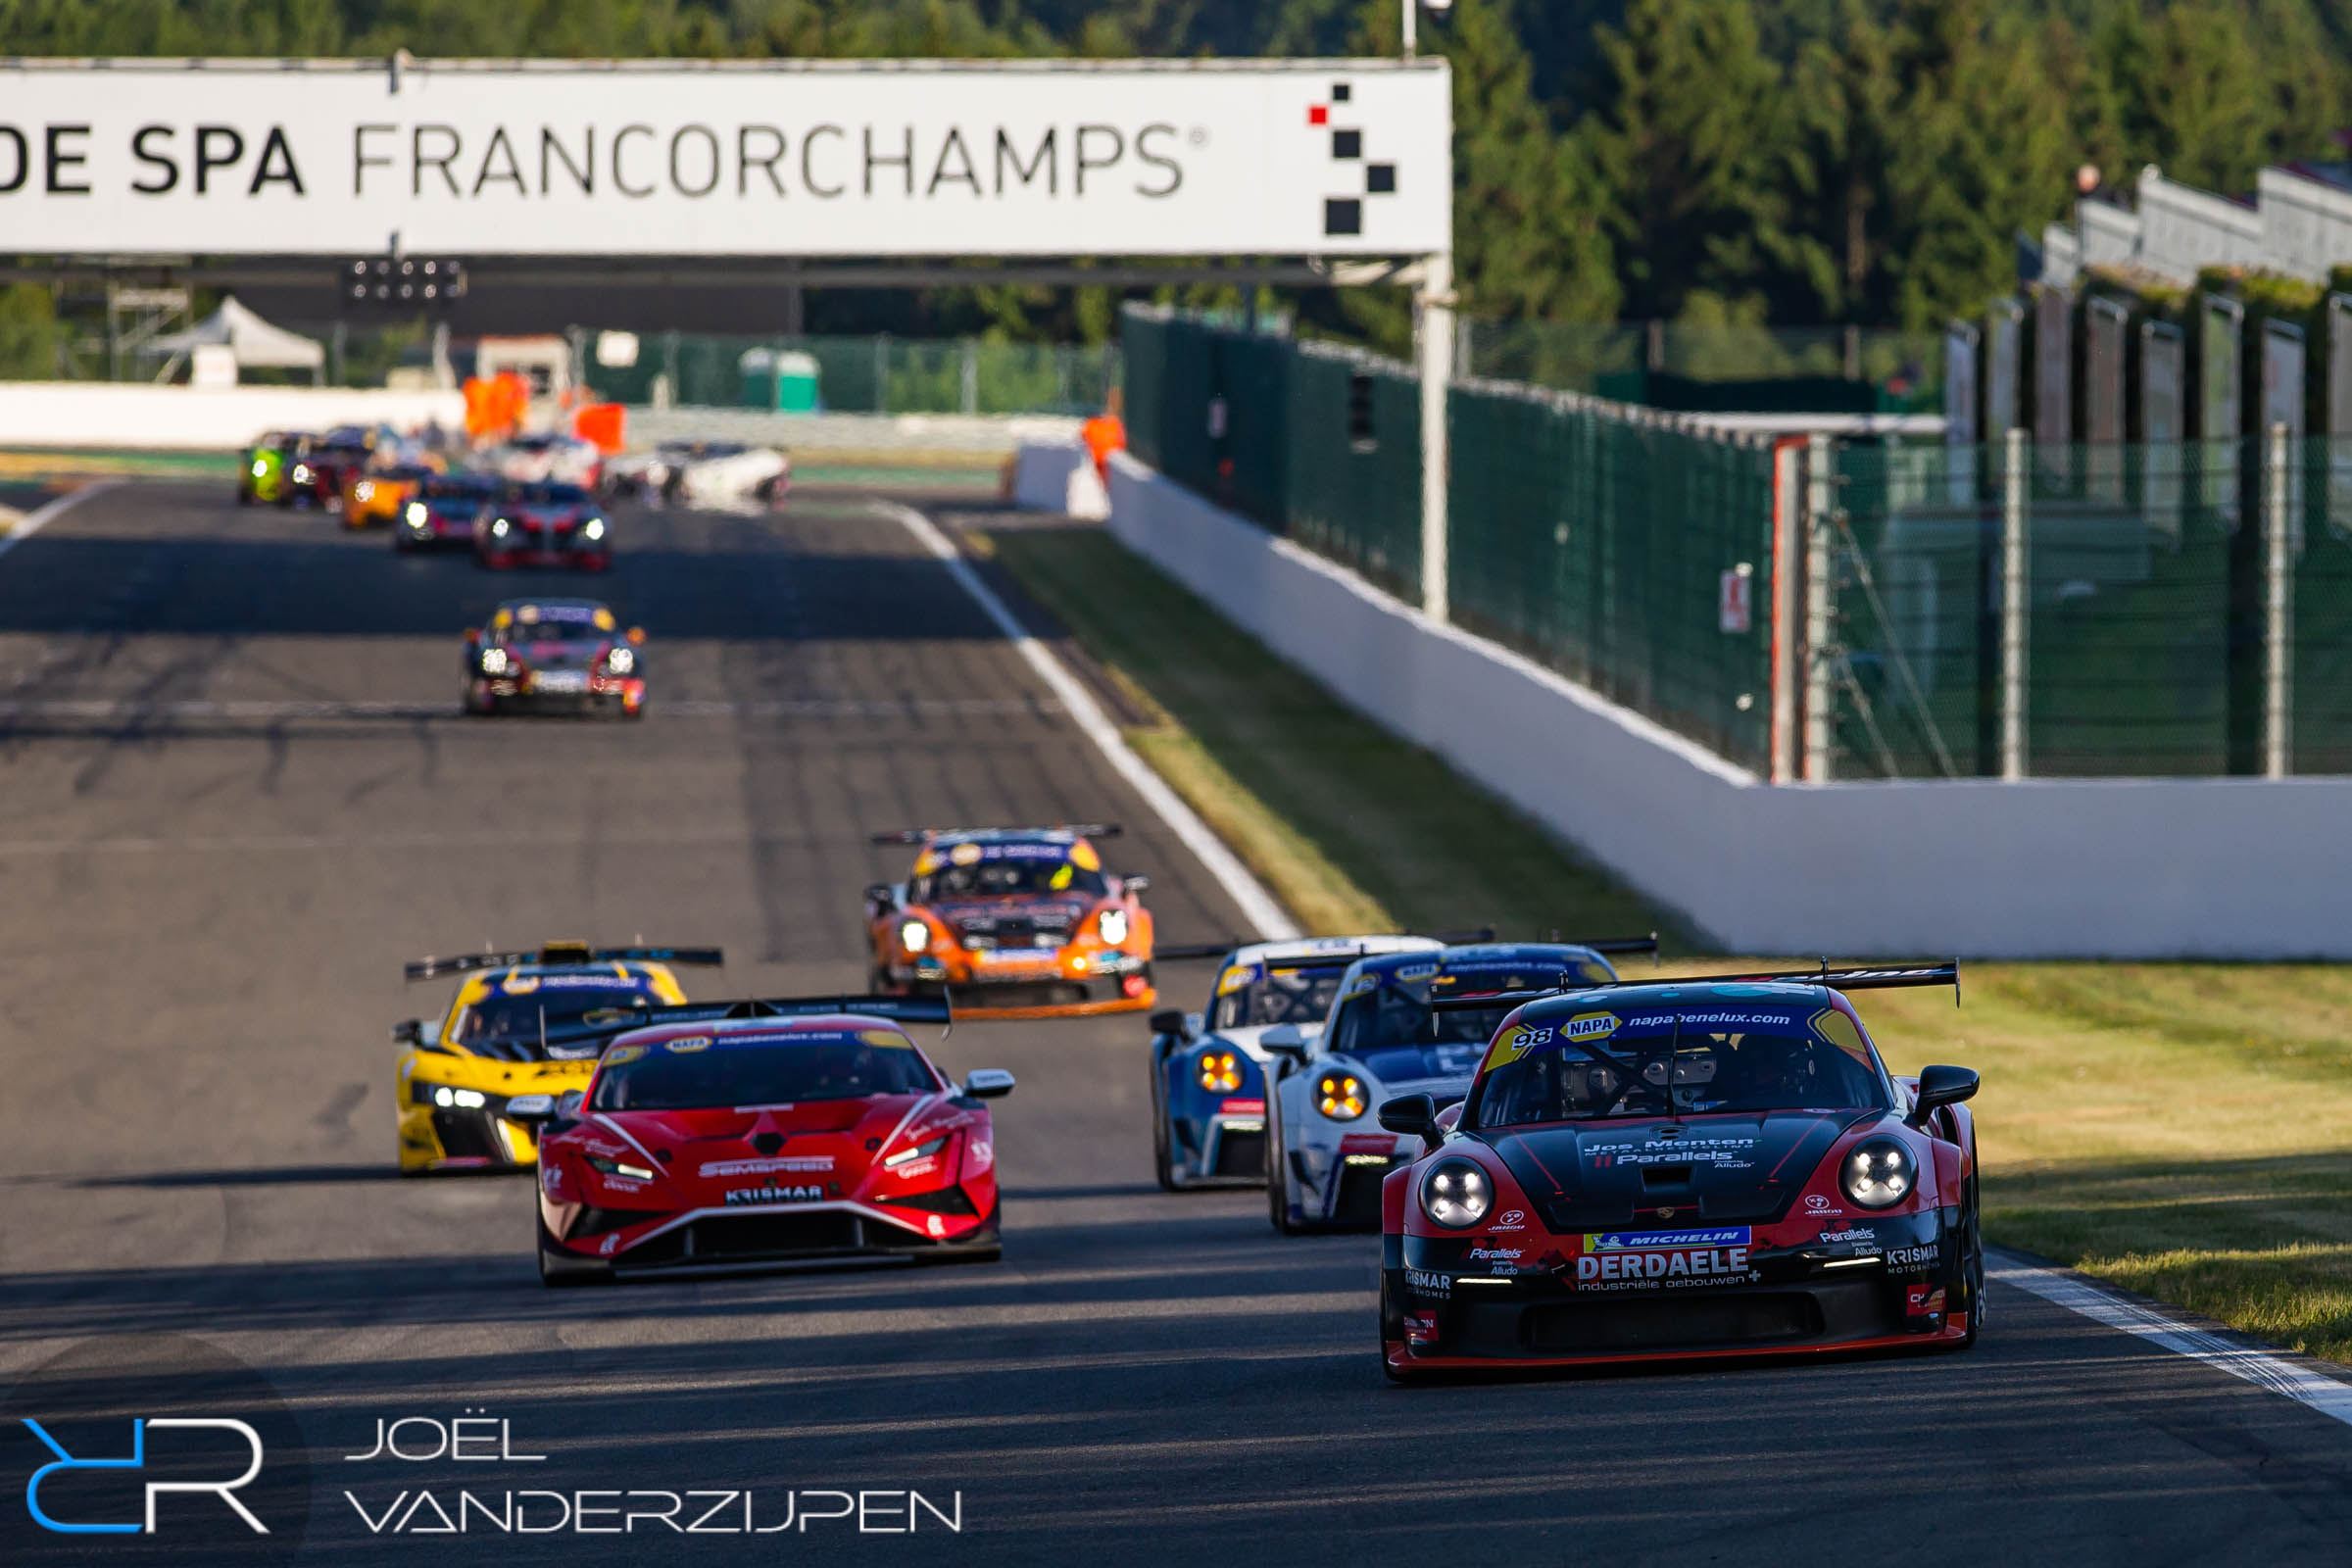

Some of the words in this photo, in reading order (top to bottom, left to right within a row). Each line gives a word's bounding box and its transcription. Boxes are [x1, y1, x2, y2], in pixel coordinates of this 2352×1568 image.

[130, 124, 306, 196] SPA
[353, 123, 1185, 198] FRANCORCHAMPS
[1569, 1018, 1615, 1036] NAPA
[1512, 1027, 1552, 1050] 98
[1584, 1144, 1634, 1152] Jos
[1644, 1138, 1754, 1149] Menten
[1617, 1151, 1735, 1165] Parallels
[725, 1185, 823, 1201] KRISMAR
[1629, 1231, 1740, 1246] MICHELIN
[1819, 1228, 1876, 1244] Parallels
[1470, 1248, 1523, 1260] Parallels
[1855, 1246, 1883, 1256] Alludo
[1886, 1244, 1939, 1265] KRISMAR
[1491, 1265, 1518, 1276] Alludo
[1577, 1248, 1749, 1280] DERDAELE
[1887, 1261, 1940, 1274] MOTORH
[1405, 1269, 1450, 1290] KRISMAR
[1578, 1279, 1660, 1292] industriële
[1665, 1275, 1745, 1289] gebouwen
